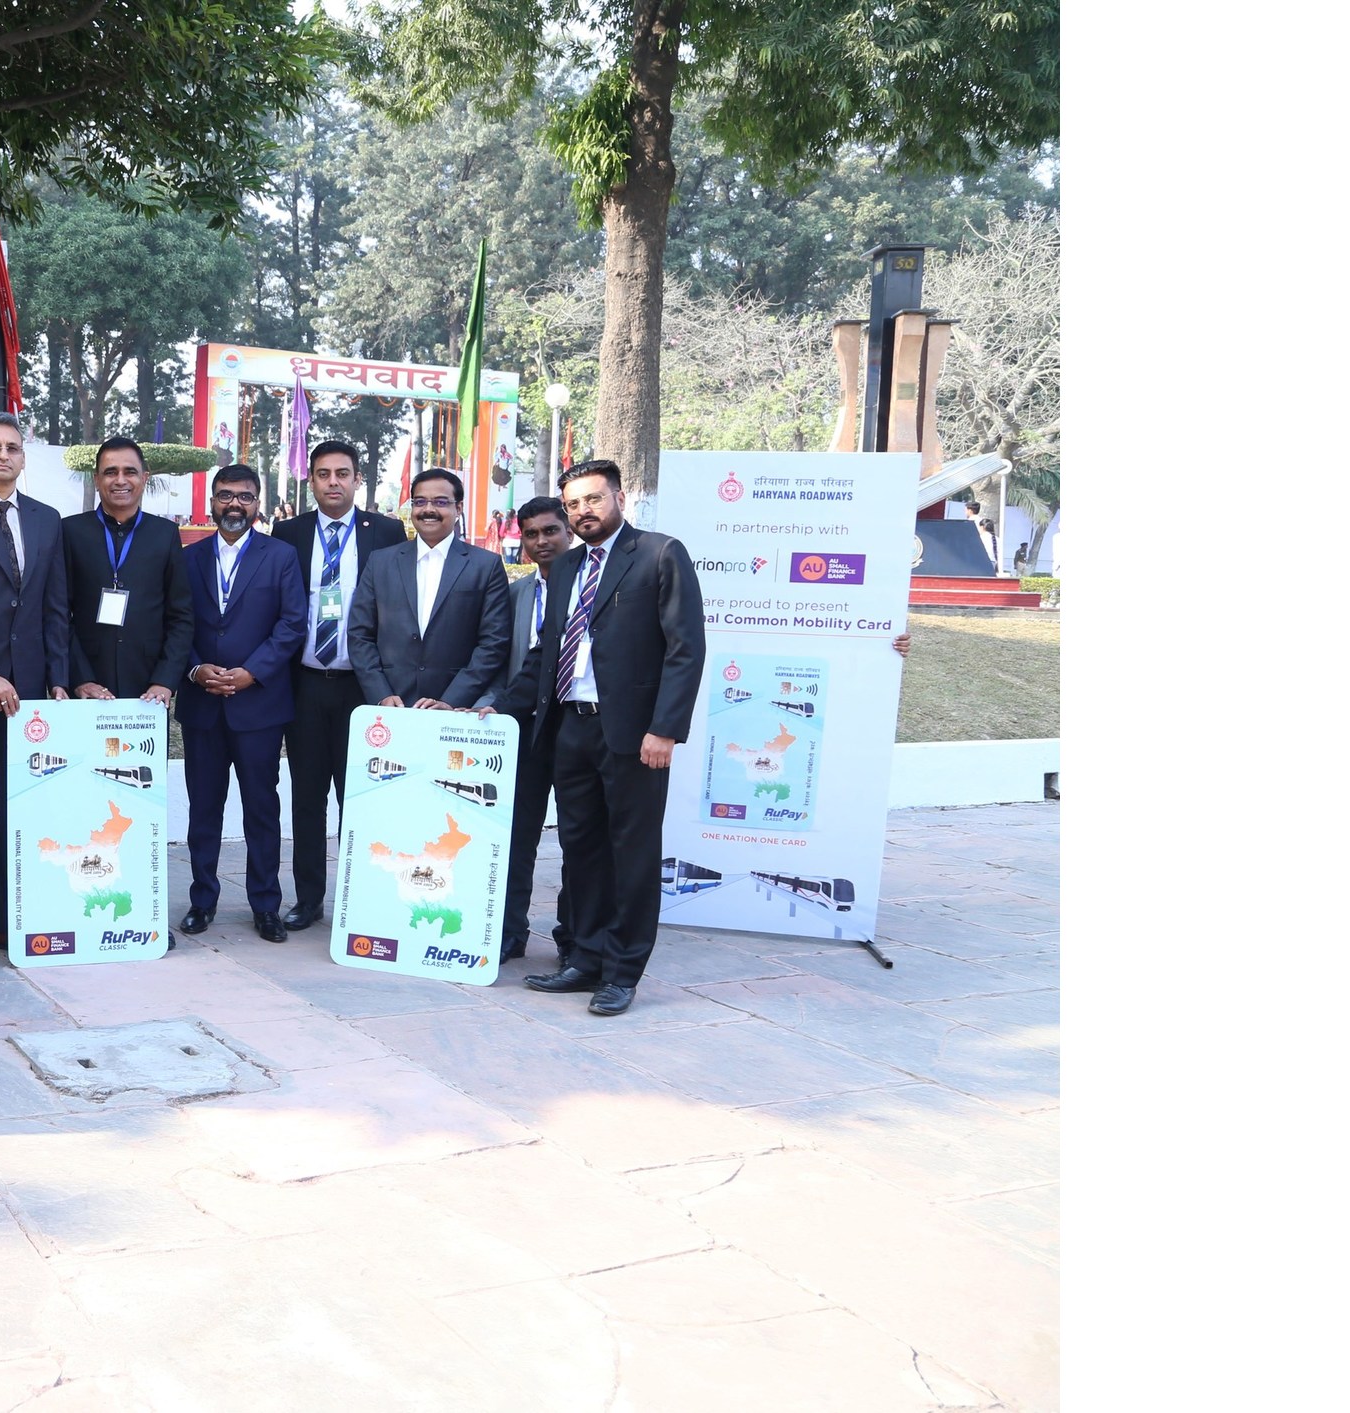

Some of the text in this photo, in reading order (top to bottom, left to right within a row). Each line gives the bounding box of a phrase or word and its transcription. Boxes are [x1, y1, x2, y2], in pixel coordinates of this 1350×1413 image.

[290, 357, 447, 393] धन्यवाद
[754, 476, 790, 486] हरियाणा
[821, 477, 854, 487] परिवहन
[753, 490, 853, 501] HARYANA ROADWAYS
[716, 521, 849, 536] in partnership with
[802, 562, 823, 573] AU
[703, 598, 850, 612] are proud to present
[725, 614, 788, 626] Common
[793, 617, 852, 631] Mobility
[857, 619, 891, 630] Card
[470, 738, 505, 746] ROADWAYS
[765, 808, 802, 820] RuPay
[702, 832, 720, 840] ONE
[723, 834, 757, 843] NATION
[344, 858, 352, 884] COMMON
[482, 923, 492, 947] नेशनल
[491, 843, 500, 858] कार्ड
[34, 940, 47, 948] AU
[101, 930, 151, 945] RuPay
[425, 945, 480, 968] RuPay
[422, 960, 452, 969] CLASSIC
